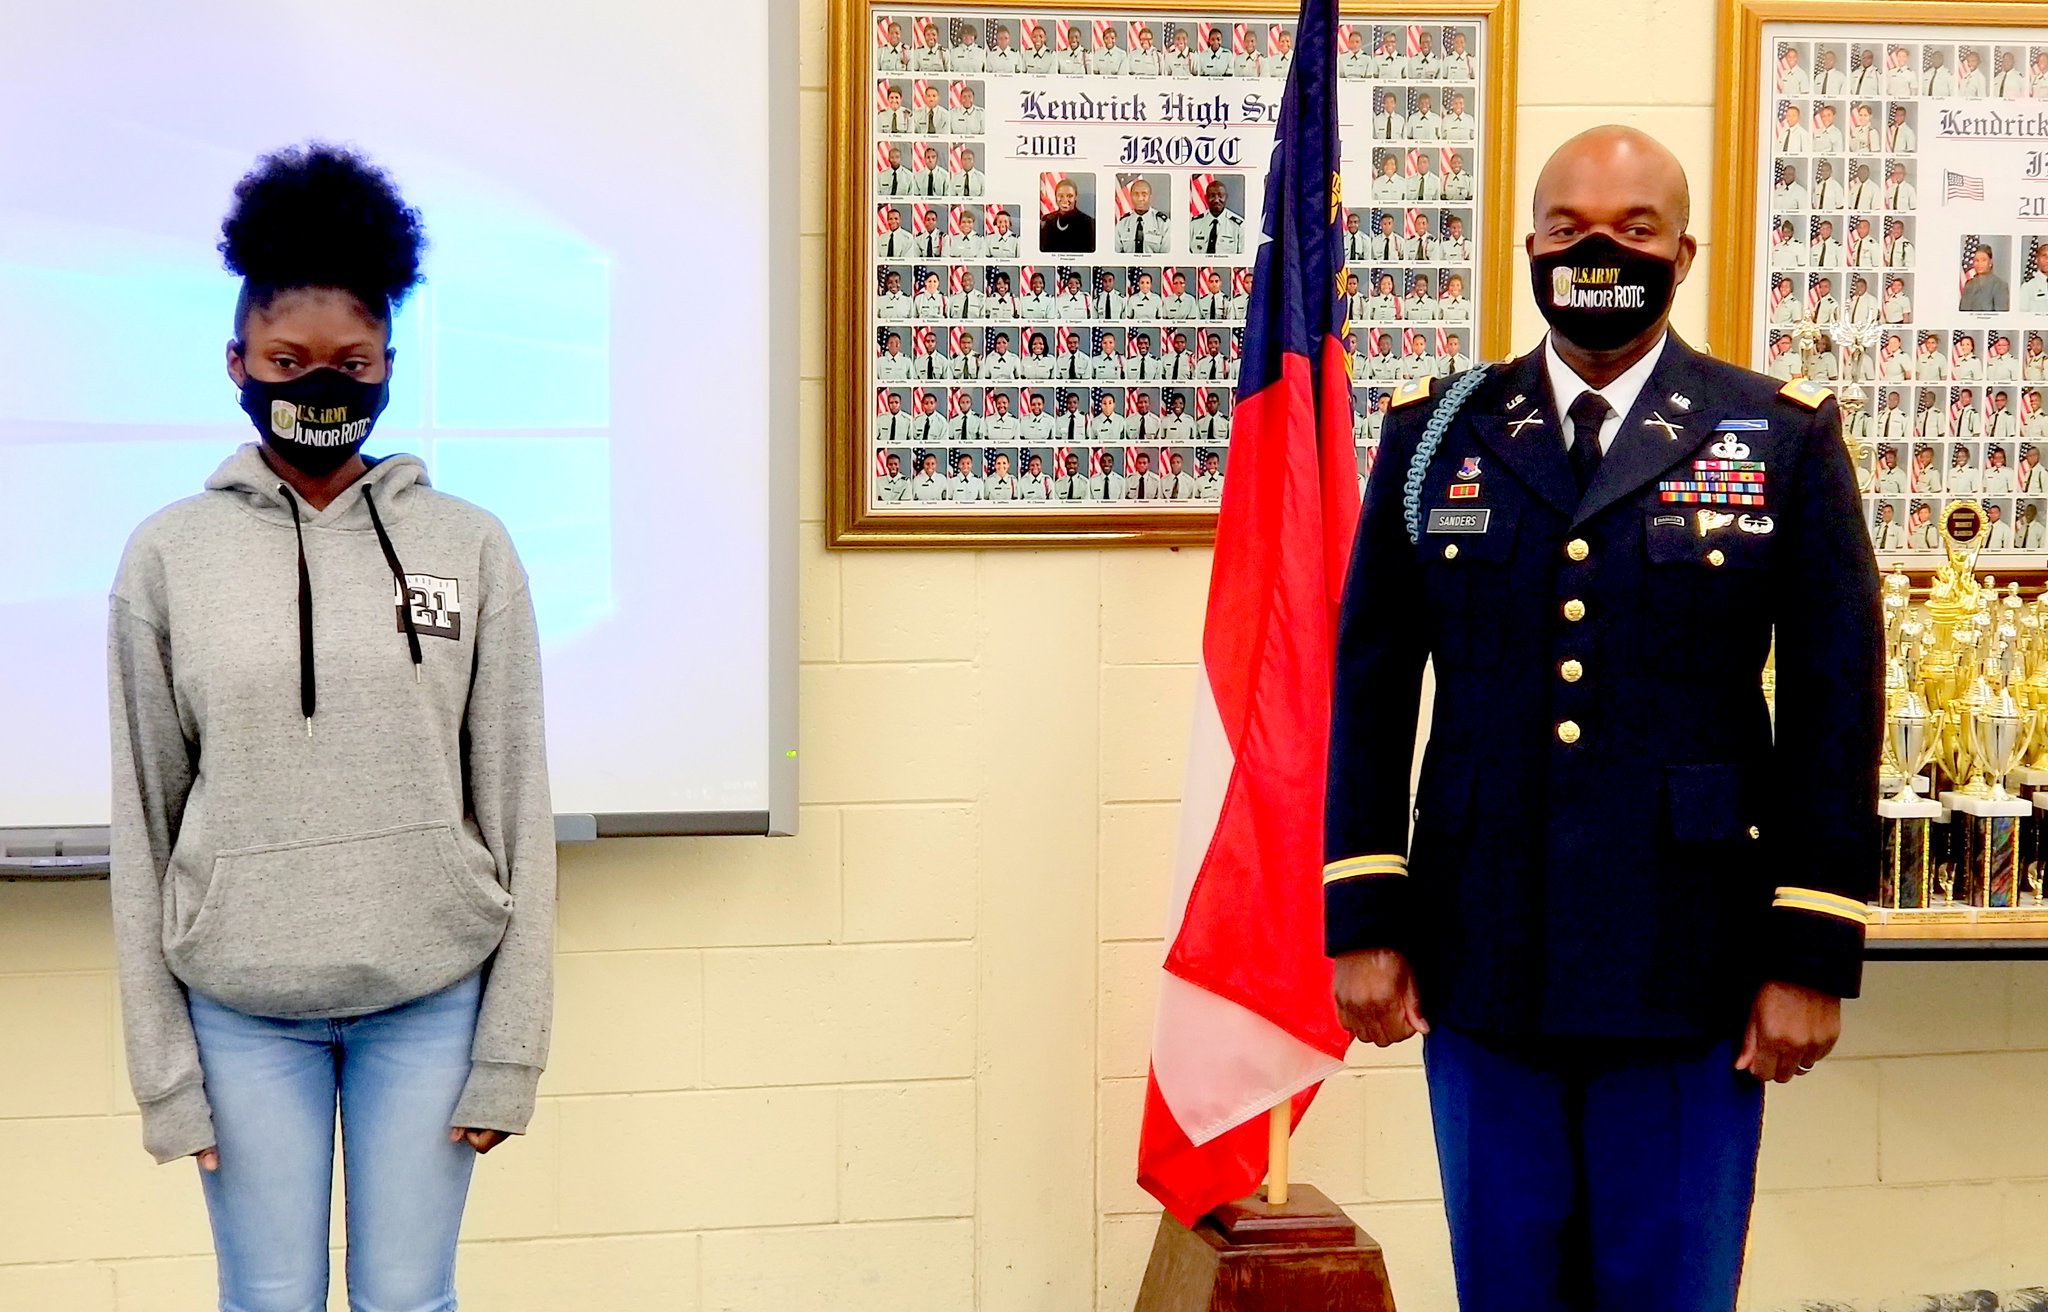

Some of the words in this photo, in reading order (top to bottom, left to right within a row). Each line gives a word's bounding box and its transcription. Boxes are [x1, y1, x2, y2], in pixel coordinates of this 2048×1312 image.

[1020, 90, 1147, 122] Kendrick
[1158, 91, 1230, 130] High
[1940, 109, 2048, 137] Kendrick
[1016, 134, 1077, 156] 2008
[1119, 135, 1243, 166] JROTC
[2018, 196, 2048, 216] 20
[1590, 267, 1621, 284] ARMY
[1614, 285, 1645, 308] ROTC
[320, 406, 347, 424] ARMY
[341, 417, 371, 445] ROTC
[1439, 516, 1476, 526] SANDERS
[407, 587, 451, 629] 21
